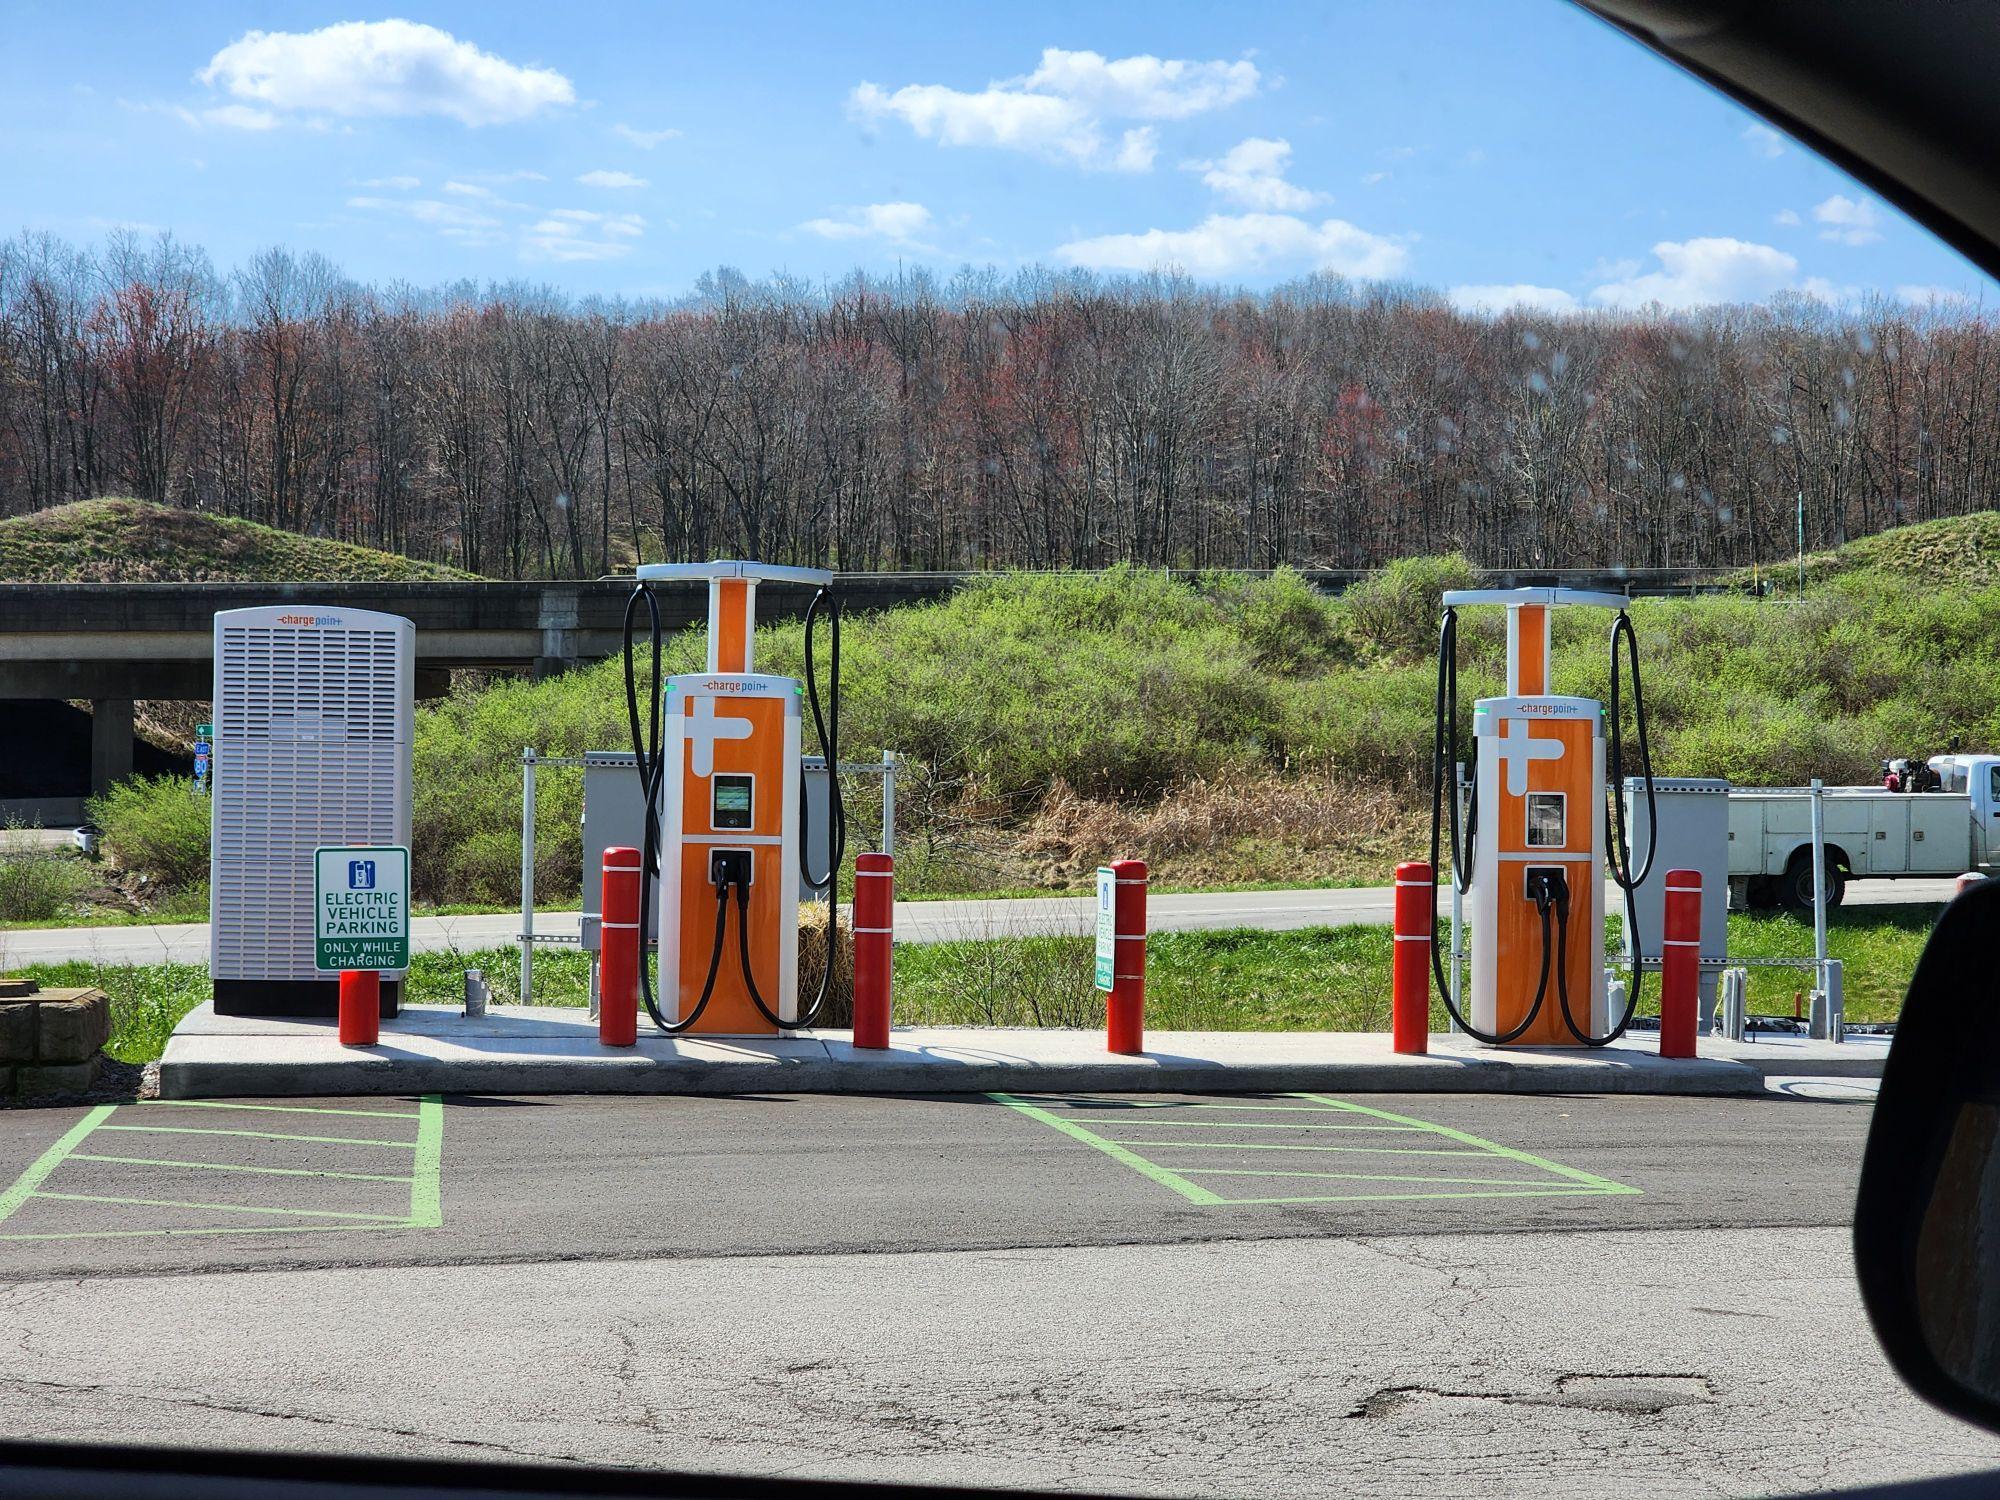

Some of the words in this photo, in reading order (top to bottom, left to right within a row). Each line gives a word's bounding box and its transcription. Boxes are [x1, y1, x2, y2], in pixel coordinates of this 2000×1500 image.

[196, 761, 207, 771] 80
[325, 893, 399, 905] ELECTRIC
[328, 907, 398, 919] VEHICLE
[326, 921, 399, 934] PARKING
[324, 942, 359, 953] ONLY
[362, 942, 401, 953] WHILE
[329, 955, 395, 967] CHARGING
